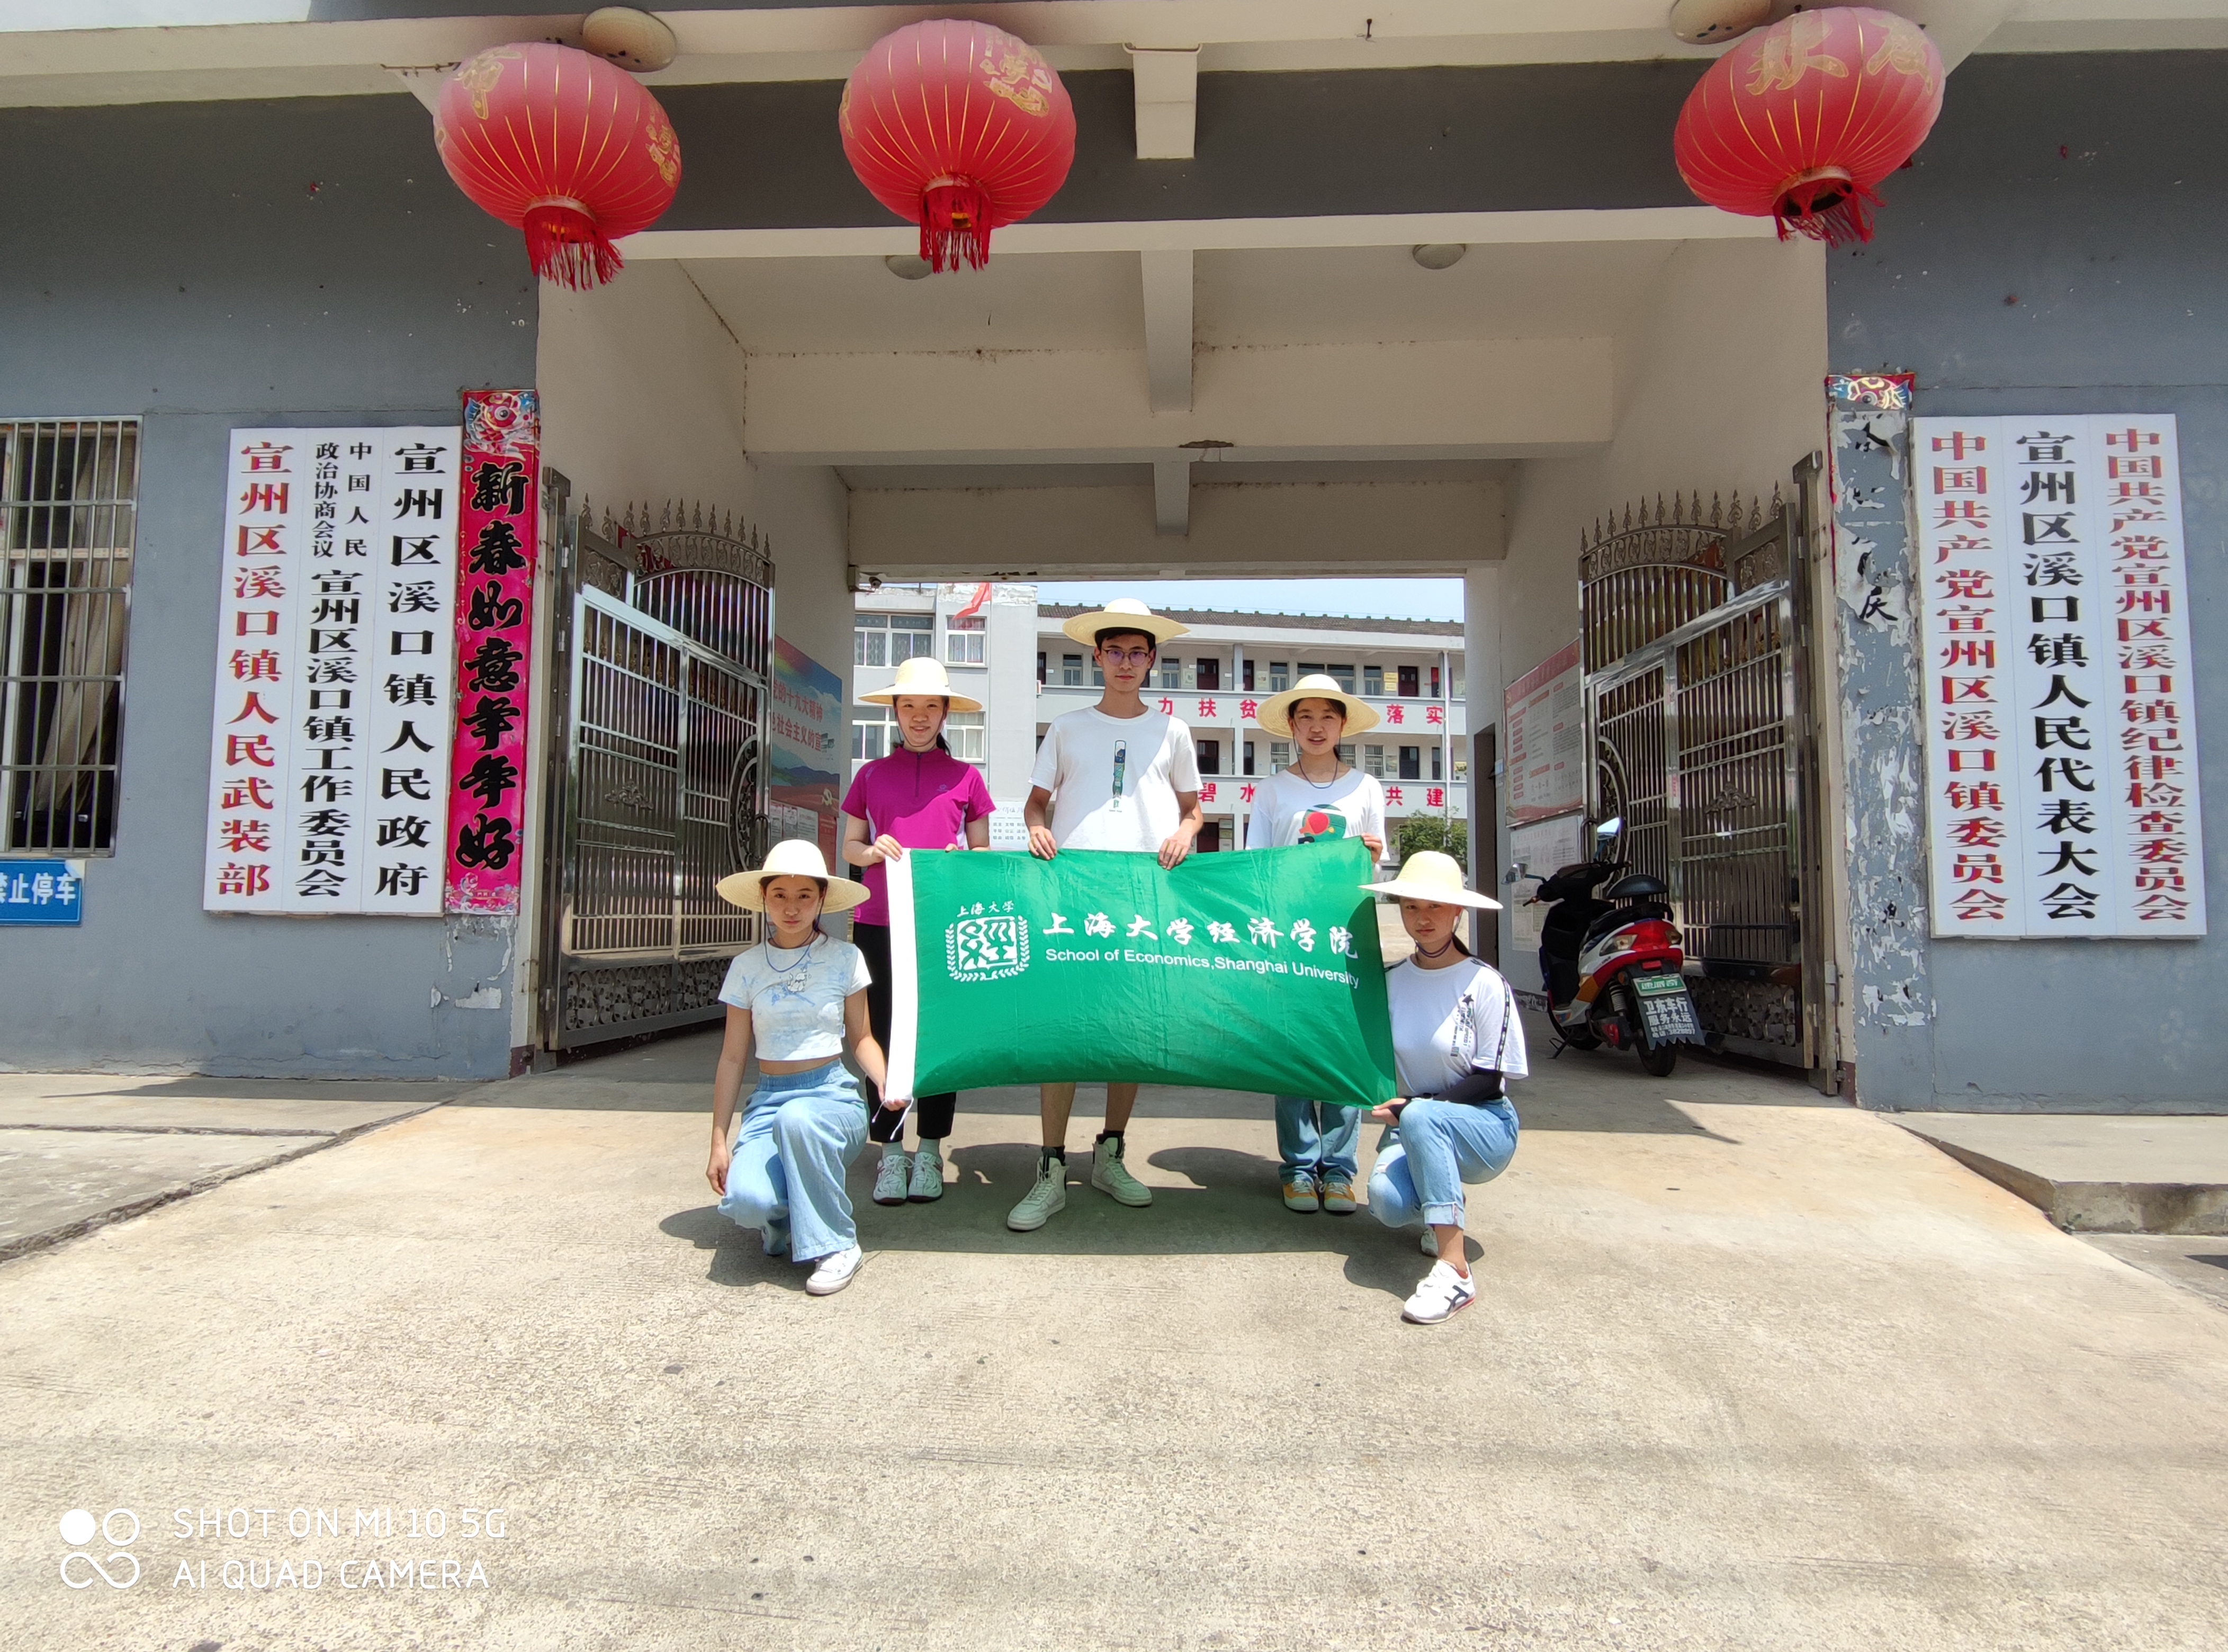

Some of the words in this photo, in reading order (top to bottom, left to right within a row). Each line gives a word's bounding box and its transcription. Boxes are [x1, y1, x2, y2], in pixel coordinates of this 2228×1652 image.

[216, 441, 292, 897] 宣州区溪口镇人民武装部
[311, 443, 339, 558] 政治协商会议
[344, 443, 373, 557] 中国人民
[374, 443, 447, 896] 宣州区溪口镇人民政府
[455, 462, 529, 871] 新春如意年年好
[1931, 430, 2010, 920] 中国共产党宣州区溪口镇委员会
[2015, 431, 2099, 919] 宣州区溪口镇人民代表大会
[2106, 428, 2192, 921] 中国共产党宣州区溪口镇纪律检查委员会
[295, 570, 363, 897] 宣州区溪口镇工作委员会
[956, 900, 1014, 918] 上海大学
[1043, 912, 1359, 959] 上海大学经济学院
[1046, 948, 1100, 962] School
[1104, 949, 1120, 962] of
[1293, 961, 1360, 989] University
